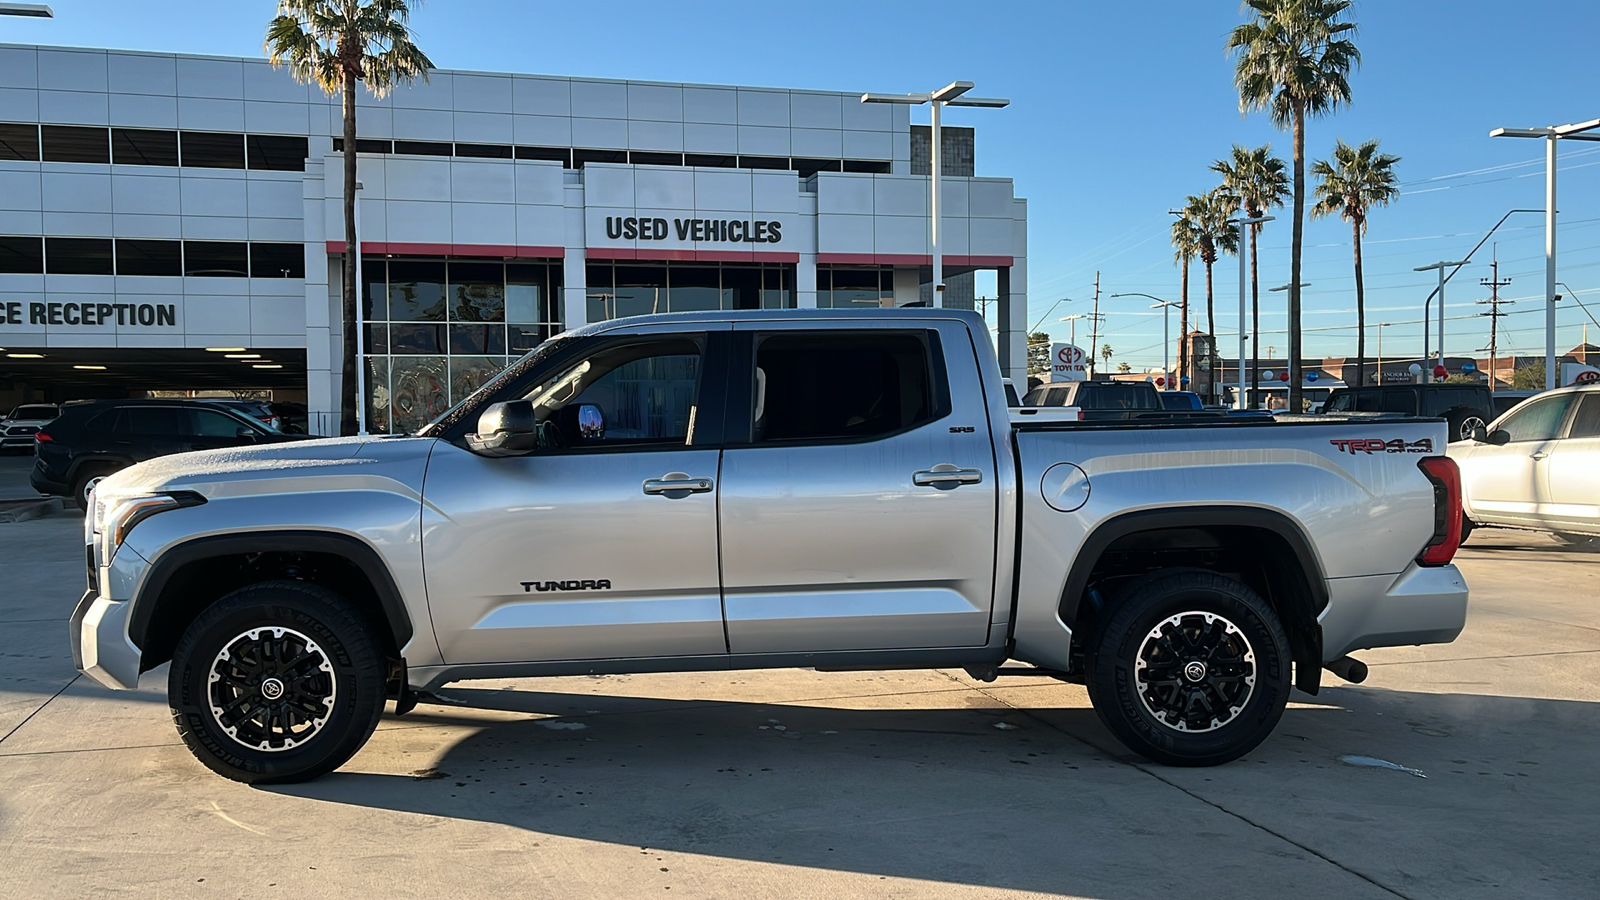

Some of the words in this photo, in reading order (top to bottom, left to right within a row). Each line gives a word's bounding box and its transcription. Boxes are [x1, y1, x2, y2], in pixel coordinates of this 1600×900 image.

[606, 217, 668, 240] USED
[675, 219, 782, 243] VEHICLES
[29, 302, 175, 326] RECEPTION
[1330, 439, 1386, 455] TRD
[520, 579, 611, 592] TUNDRA
[297, 613, 350, 664] MICHELIN
[190, 715, 243, 767] MICHELIN
